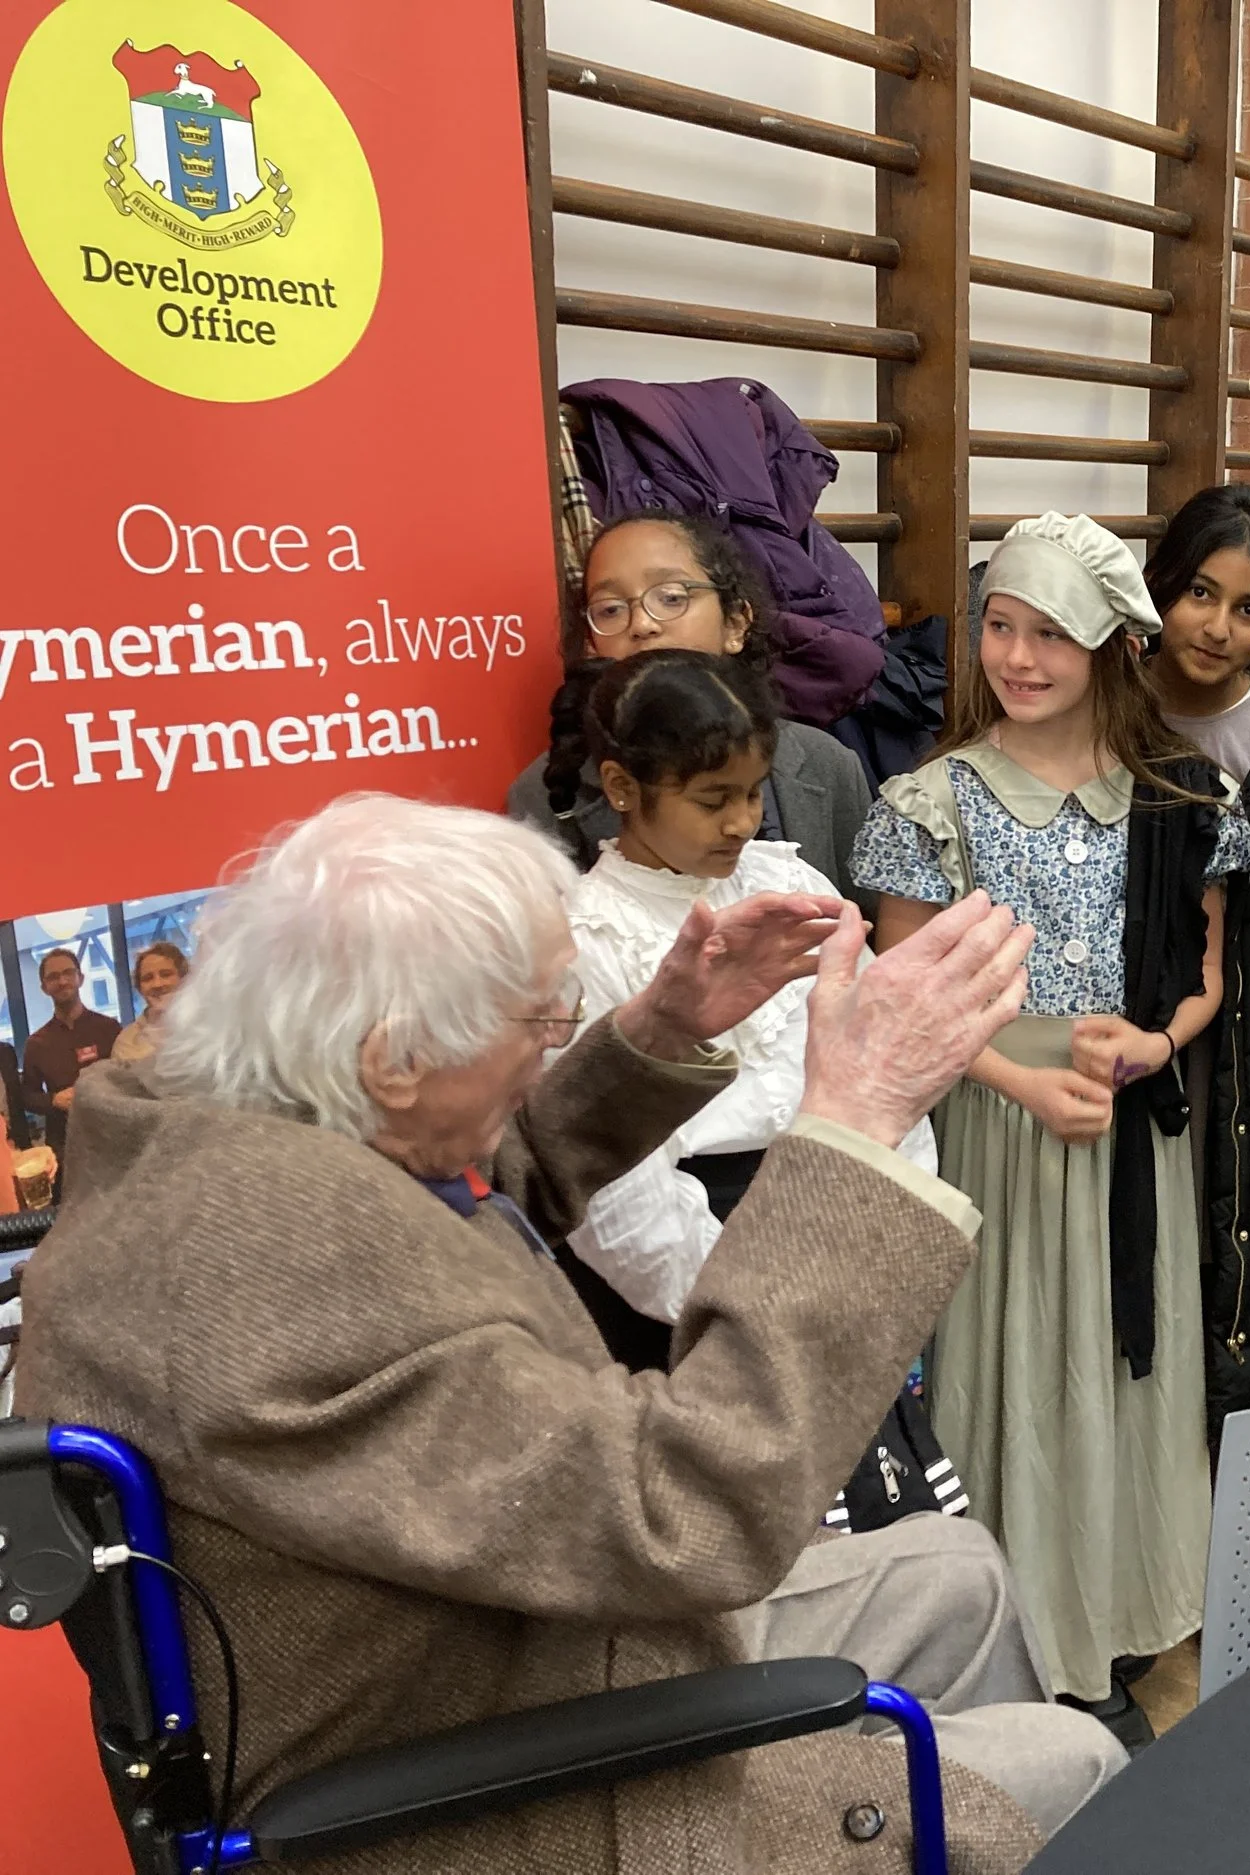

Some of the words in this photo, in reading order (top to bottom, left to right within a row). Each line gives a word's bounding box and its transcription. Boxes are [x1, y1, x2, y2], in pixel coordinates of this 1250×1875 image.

[133, 196, 161, 222] HIGH
[162, 219, 198, 243] MERIT
[201, 233, 230, 247] HIGH
[233, 216, 273, 241] REWARD
[80, 246, 338, 308] Development
[157, 303, 276, 346] Office
[118, 504, 310, 575] Once
[328, 525, 366, 572] a
[0, 603, 328, 700] ymerian,
[346, 600, 526, 671] always
[9, 738, 54, 791] a
[66, 693, 477, 792] Hymerian...
